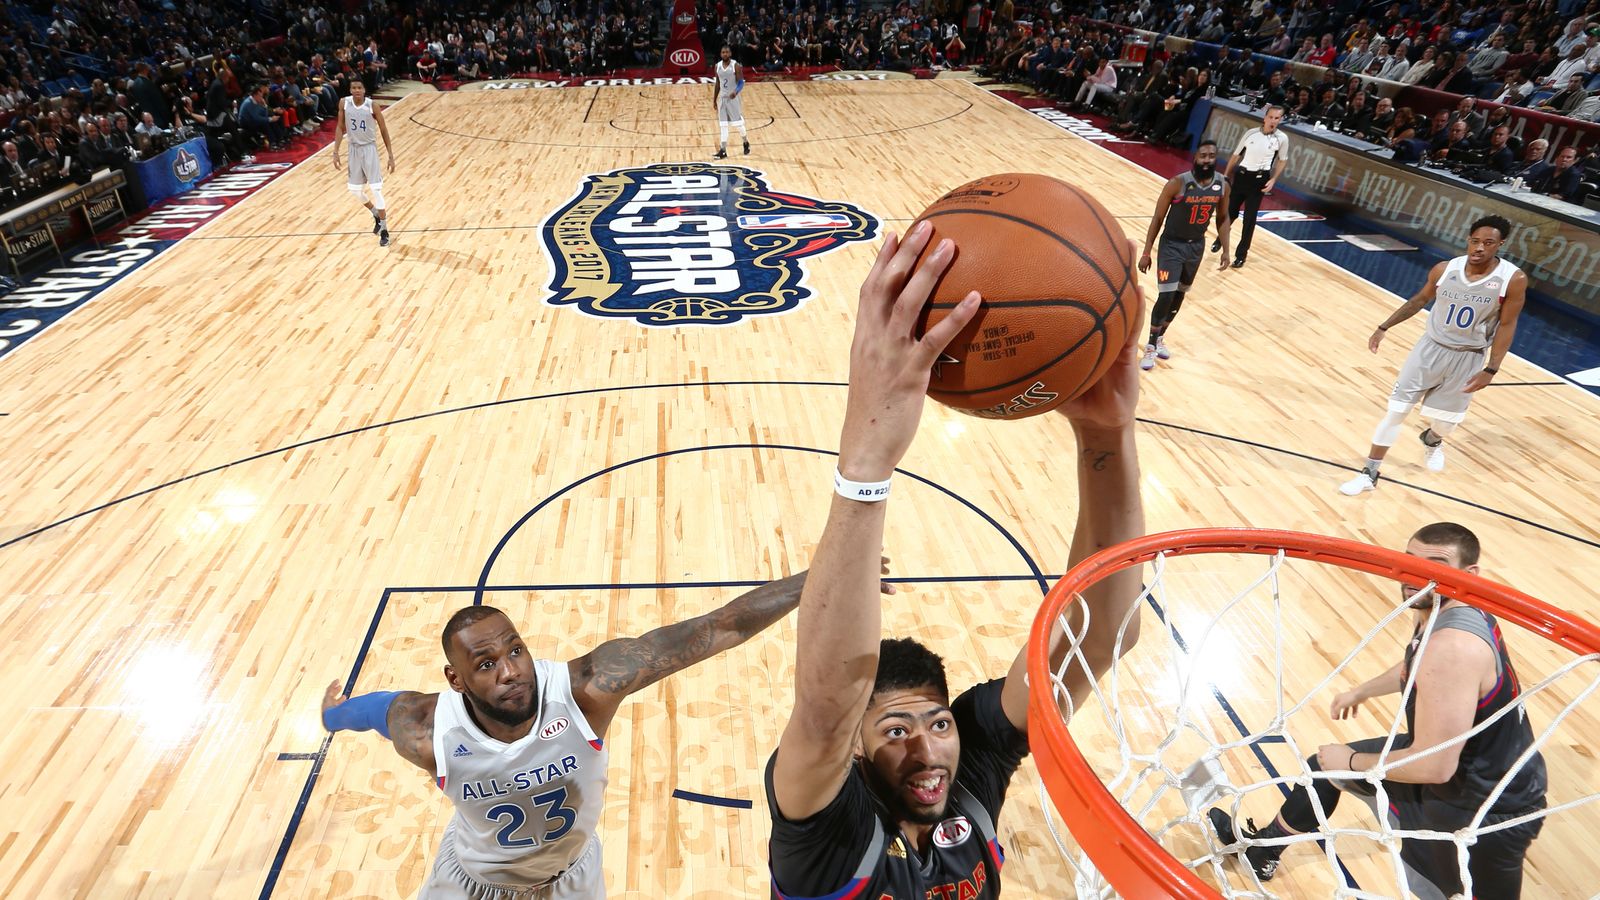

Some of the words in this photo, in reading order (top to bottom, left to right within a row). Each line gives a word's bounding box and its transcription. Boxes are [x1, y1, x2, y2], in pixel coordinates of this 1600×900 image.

[675, 52, 695, 62] KIA
[482, 79, 571, 90] NEW
[583, 77, 718, 86] ORLEAN
[809, 73, 887, 81] 2017
[723, 79, 728, 88] 2
[350, 118, 367, 132] 34
[178, 172, 280, 200] NBA
[591, 184, 621, 200] NEW
[1352, 168, 1417, 221] NEW
[91, 198, 115, 218] SUNDAY
[1189, 204, 1212, 225] 13
[558, 204, 603, 247] ORLEANS
[29, 229, 50, 248] STAR
[608, 215, 741, 296] STAR
[569, 252, 604, 281] 2017
[1445, 303, 1475, 329] 10
[983, 325, 1009, 339] @NBA
[1004, 331, 1035, 347] OFFICIAL
[982, 347, 1017, 361] ALL-STAR
[983, 338, 1002, 351] GAME
[544, 721, 564, 737] KIA
[462, 755, 580, 800] ALL-STAR
[485, 786, 578, 848] 23
[938, 822, 967, 842] KIA
